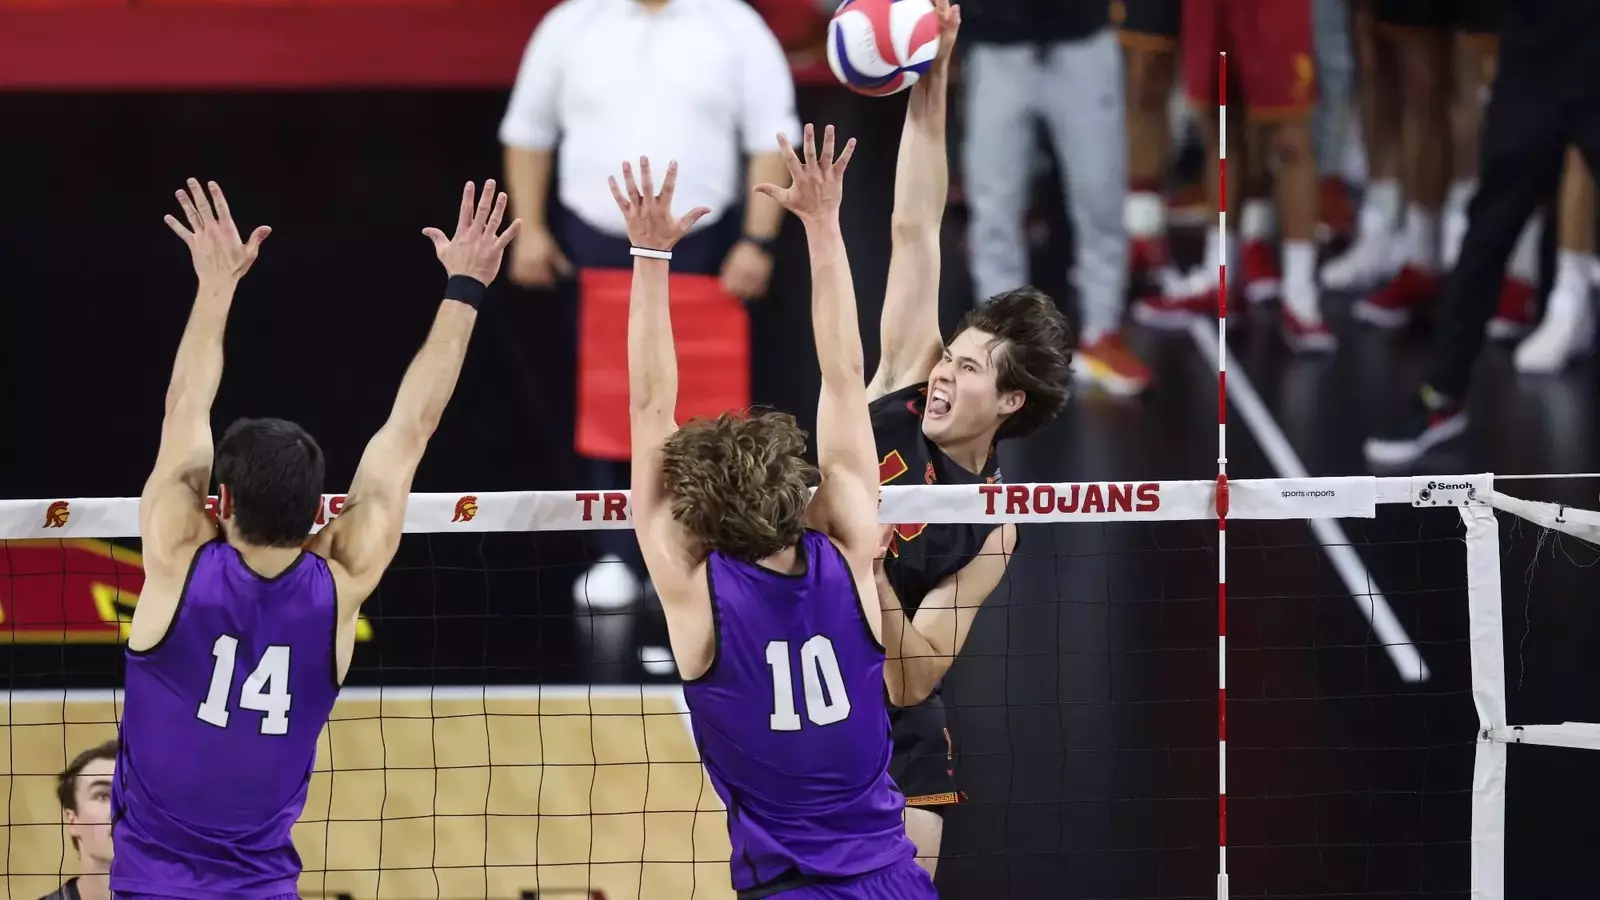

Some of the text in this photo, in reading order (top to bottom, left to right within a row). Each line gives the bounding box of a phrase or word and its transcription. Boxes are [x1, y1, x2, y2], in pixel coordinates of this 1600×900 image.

[979, 483, 1160, 515] TROJANS
[1281, 490, 1305, 498] sports
[1437, 481, 1473, 490] Senoh
[196, 633, 292, 735] 14
[765, 634, 852, 732] 10
